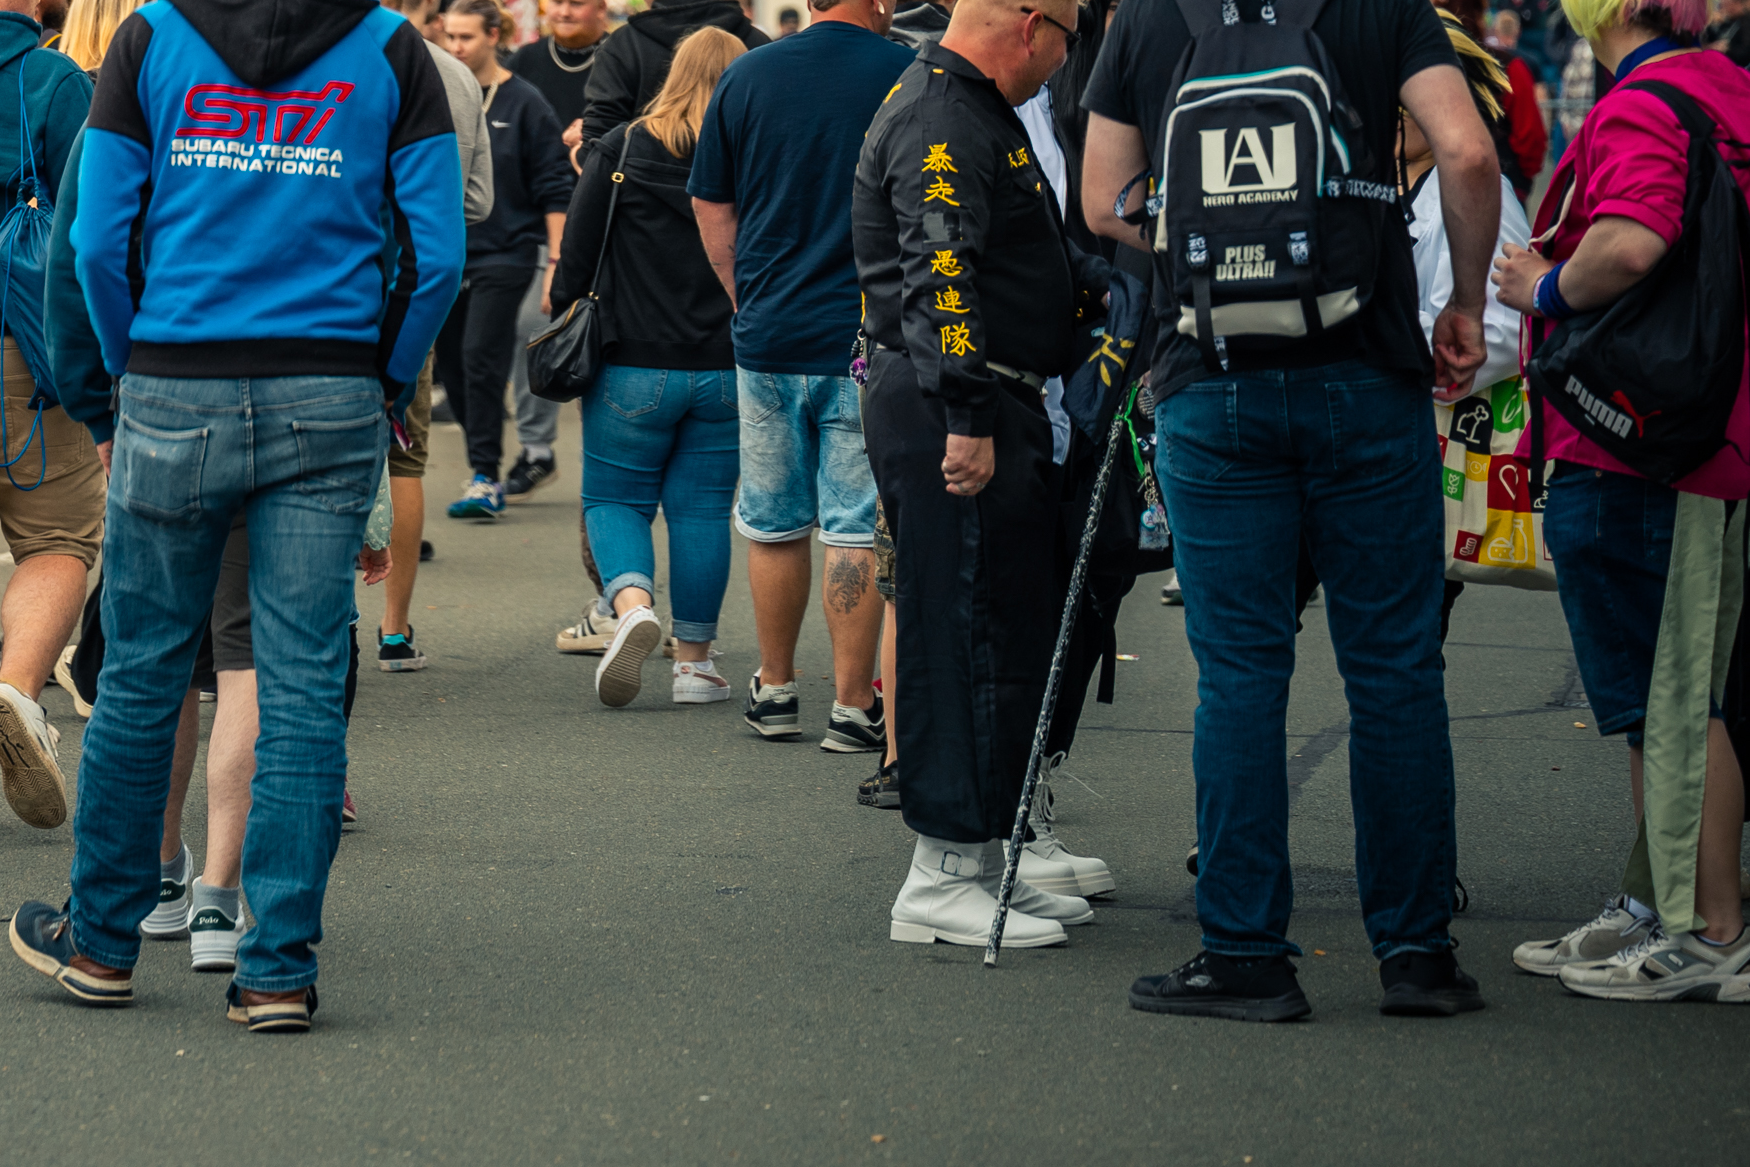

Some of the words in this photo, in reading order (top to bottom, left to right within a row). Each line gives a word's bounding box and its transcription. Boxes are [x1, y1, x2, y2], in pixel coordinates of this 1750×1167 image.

[170, 138, 254, 158] SUBARU
[258, 144, 343, 163] TECNICA
[170, 153, 342, 178] INTERNATIONAL
[1203, 194, 1235, 208] HERO
[1237, 189, 1299, 205] ACADEMY
[1224, 244, 1266, 264] PLUS
[1215, 260, 1276, 282] ULTRA!!
[1564, 374, 1634, 440] PUMA
[198, 915, 219, 925] Polo
